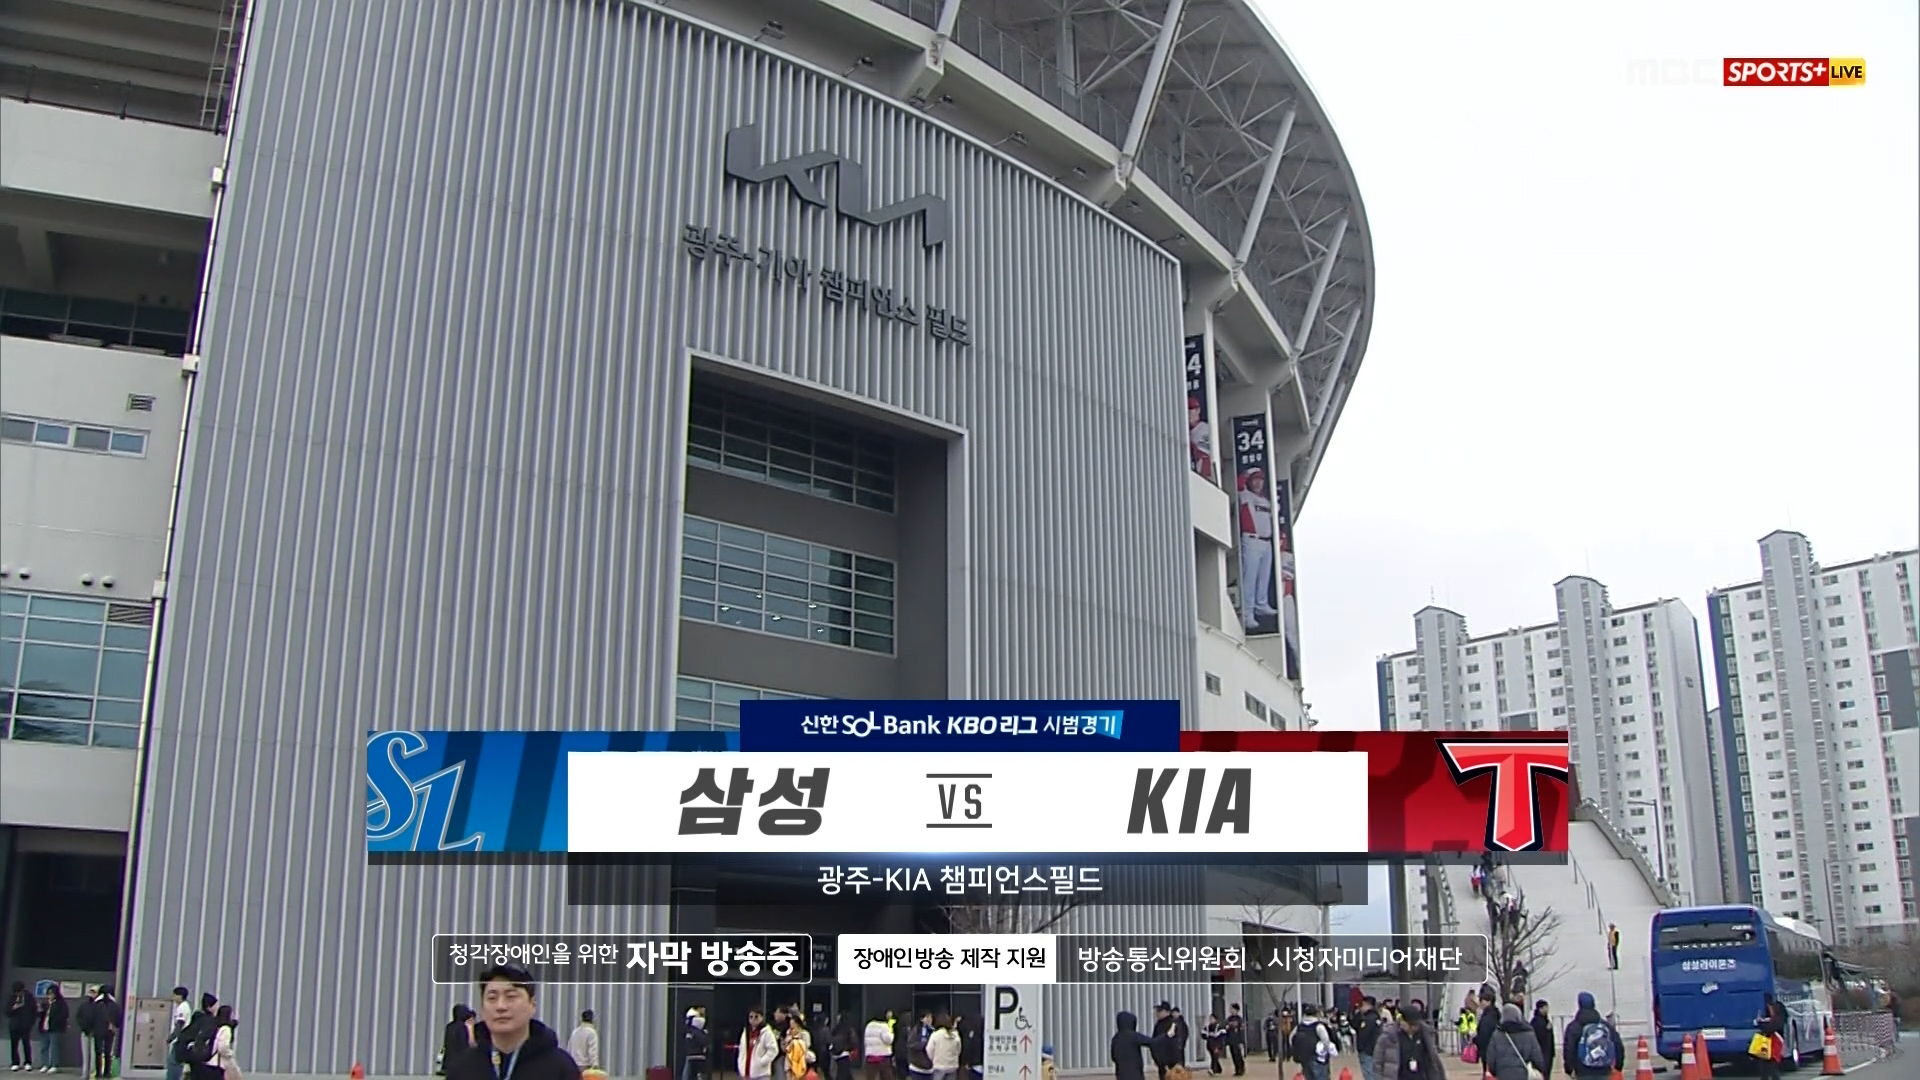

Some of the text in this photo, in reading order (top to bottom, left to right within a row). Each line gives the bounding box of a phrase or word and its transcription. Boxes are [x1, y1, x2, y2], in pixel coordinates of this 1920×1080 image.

[682, 223, 813, 291] 광주-기아
[1237, 429, 1265, 452] 34
[994, 987, 1019, 1030] P
